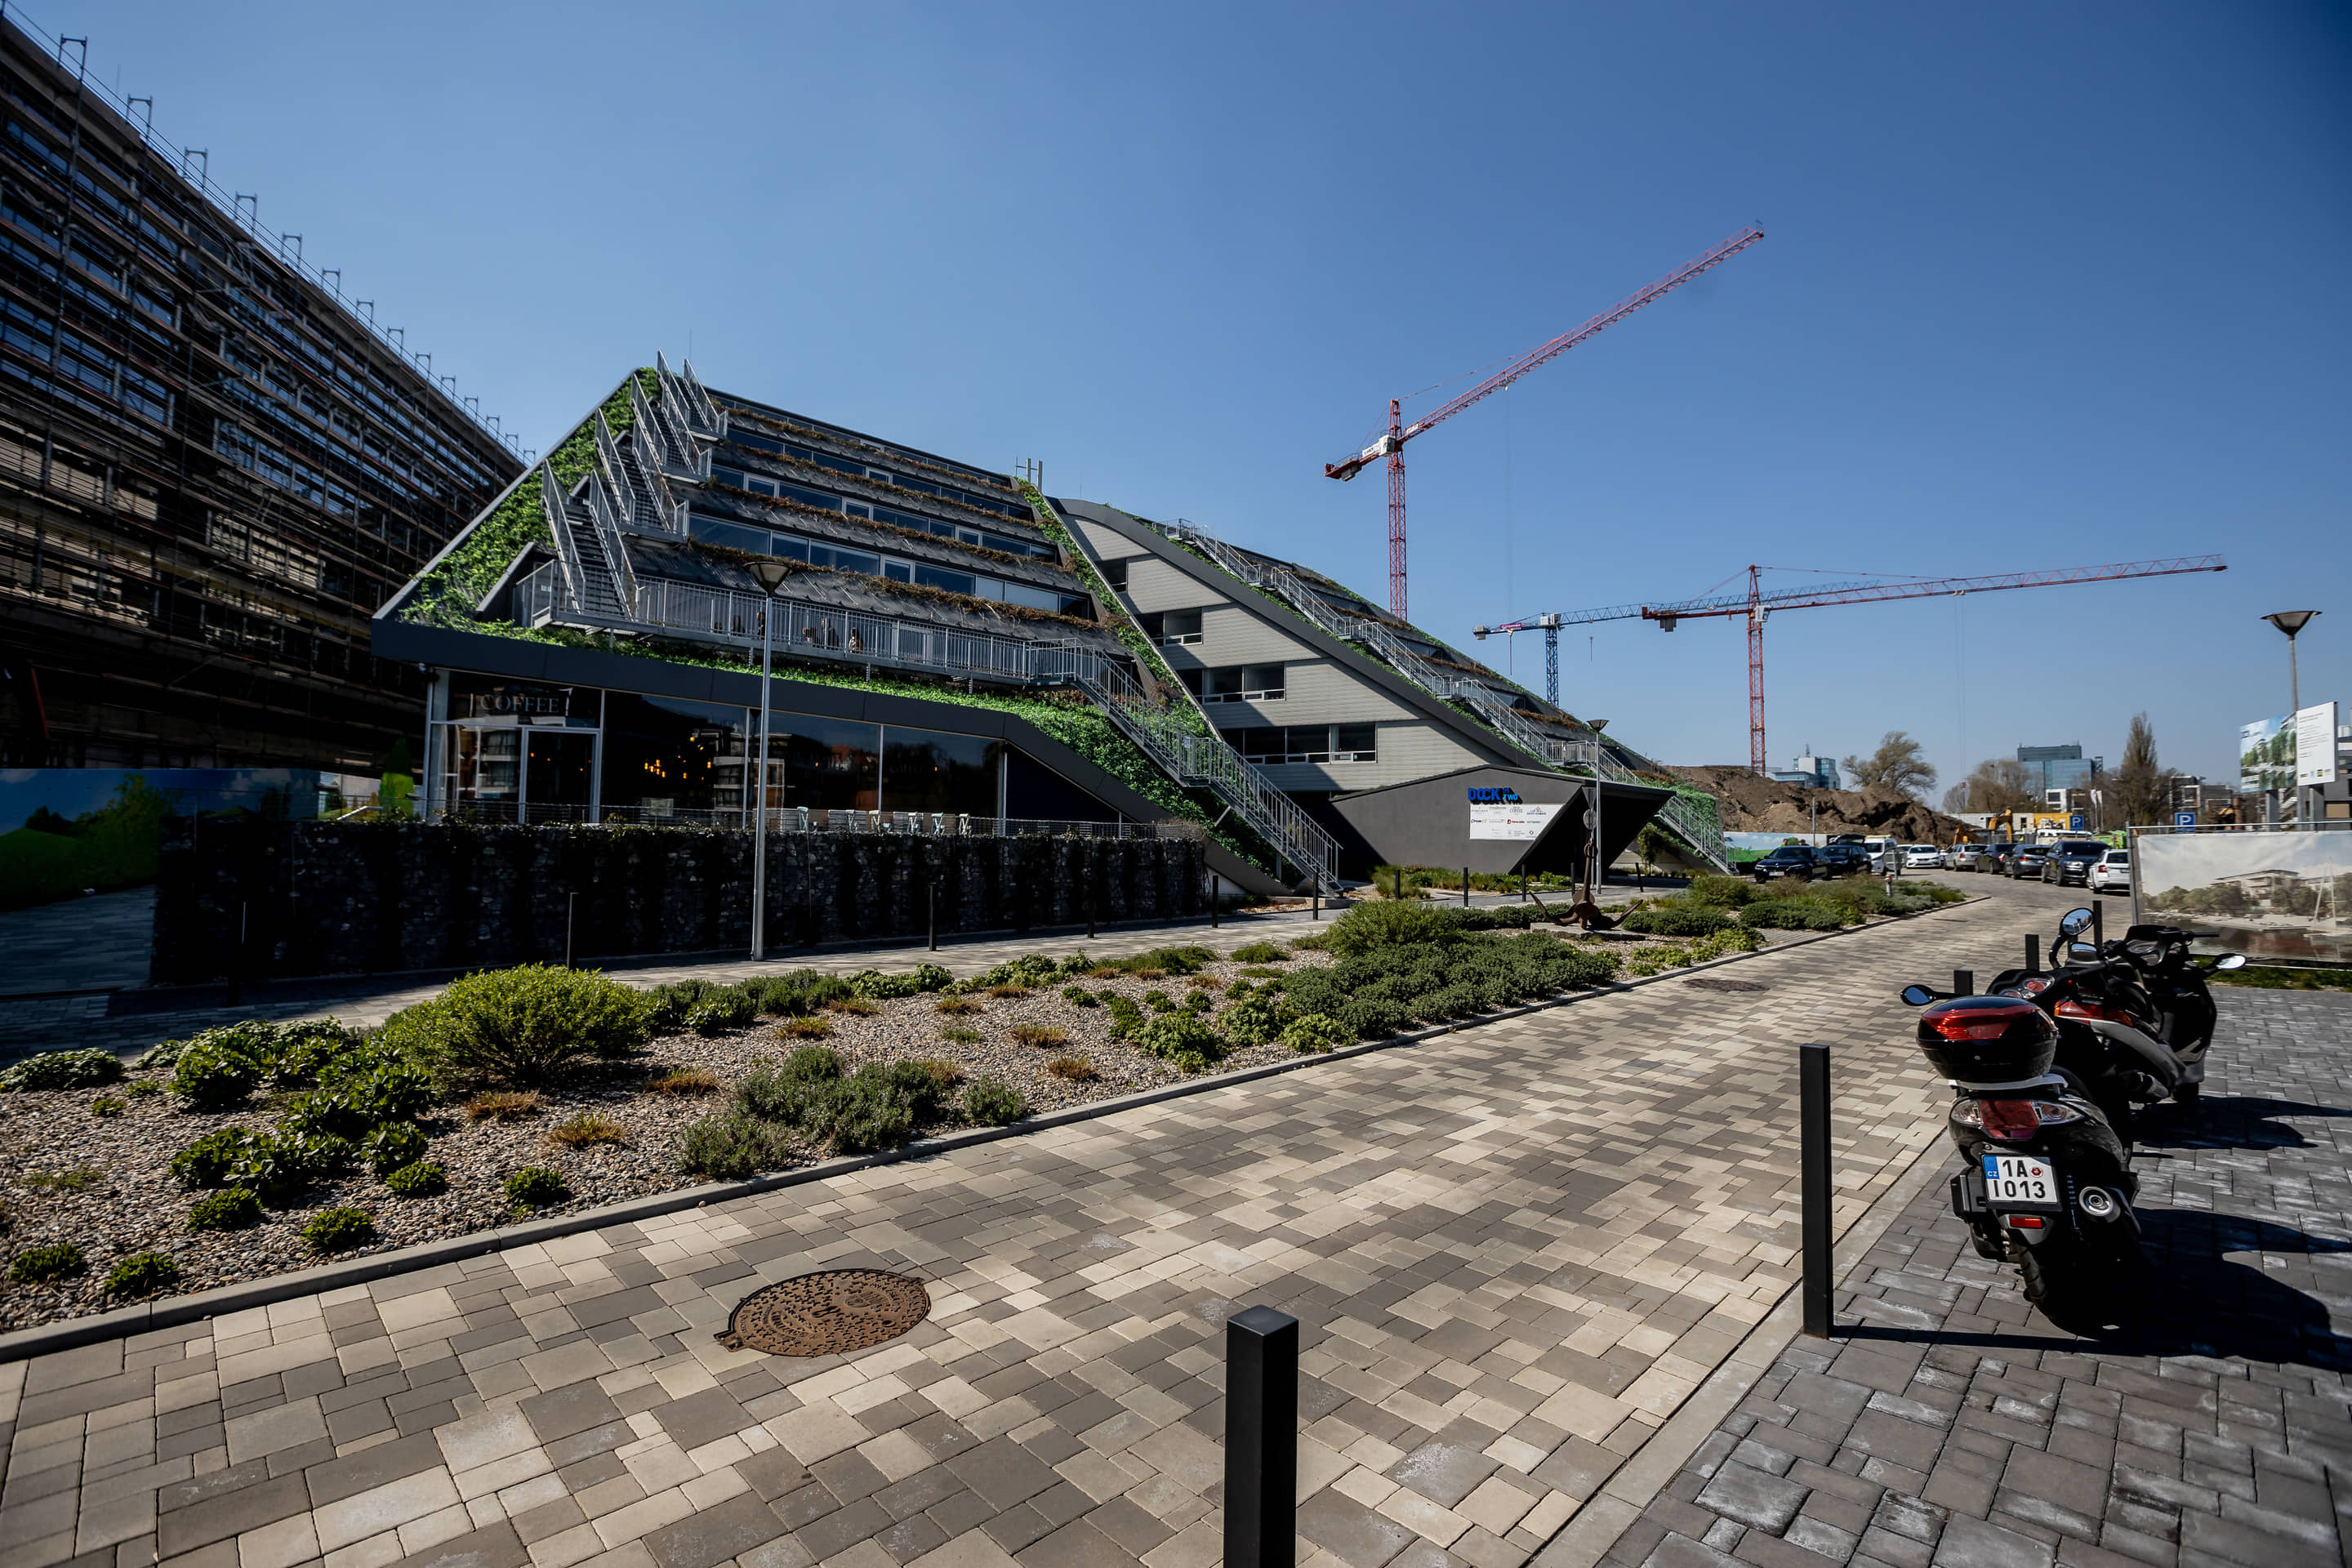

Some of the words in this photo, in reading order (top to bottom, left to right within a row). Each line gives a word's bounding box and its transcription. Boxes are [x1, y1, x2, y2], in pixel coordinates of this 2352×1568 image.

[479, 694, 559, 713] COFFEE
[1468, 787, 1502, 800] DOCK
[2072, 817, 2082, 826] P
[2180, 815, 2192, 826] P
[2002, 1160, 2029, 1178] 1A
